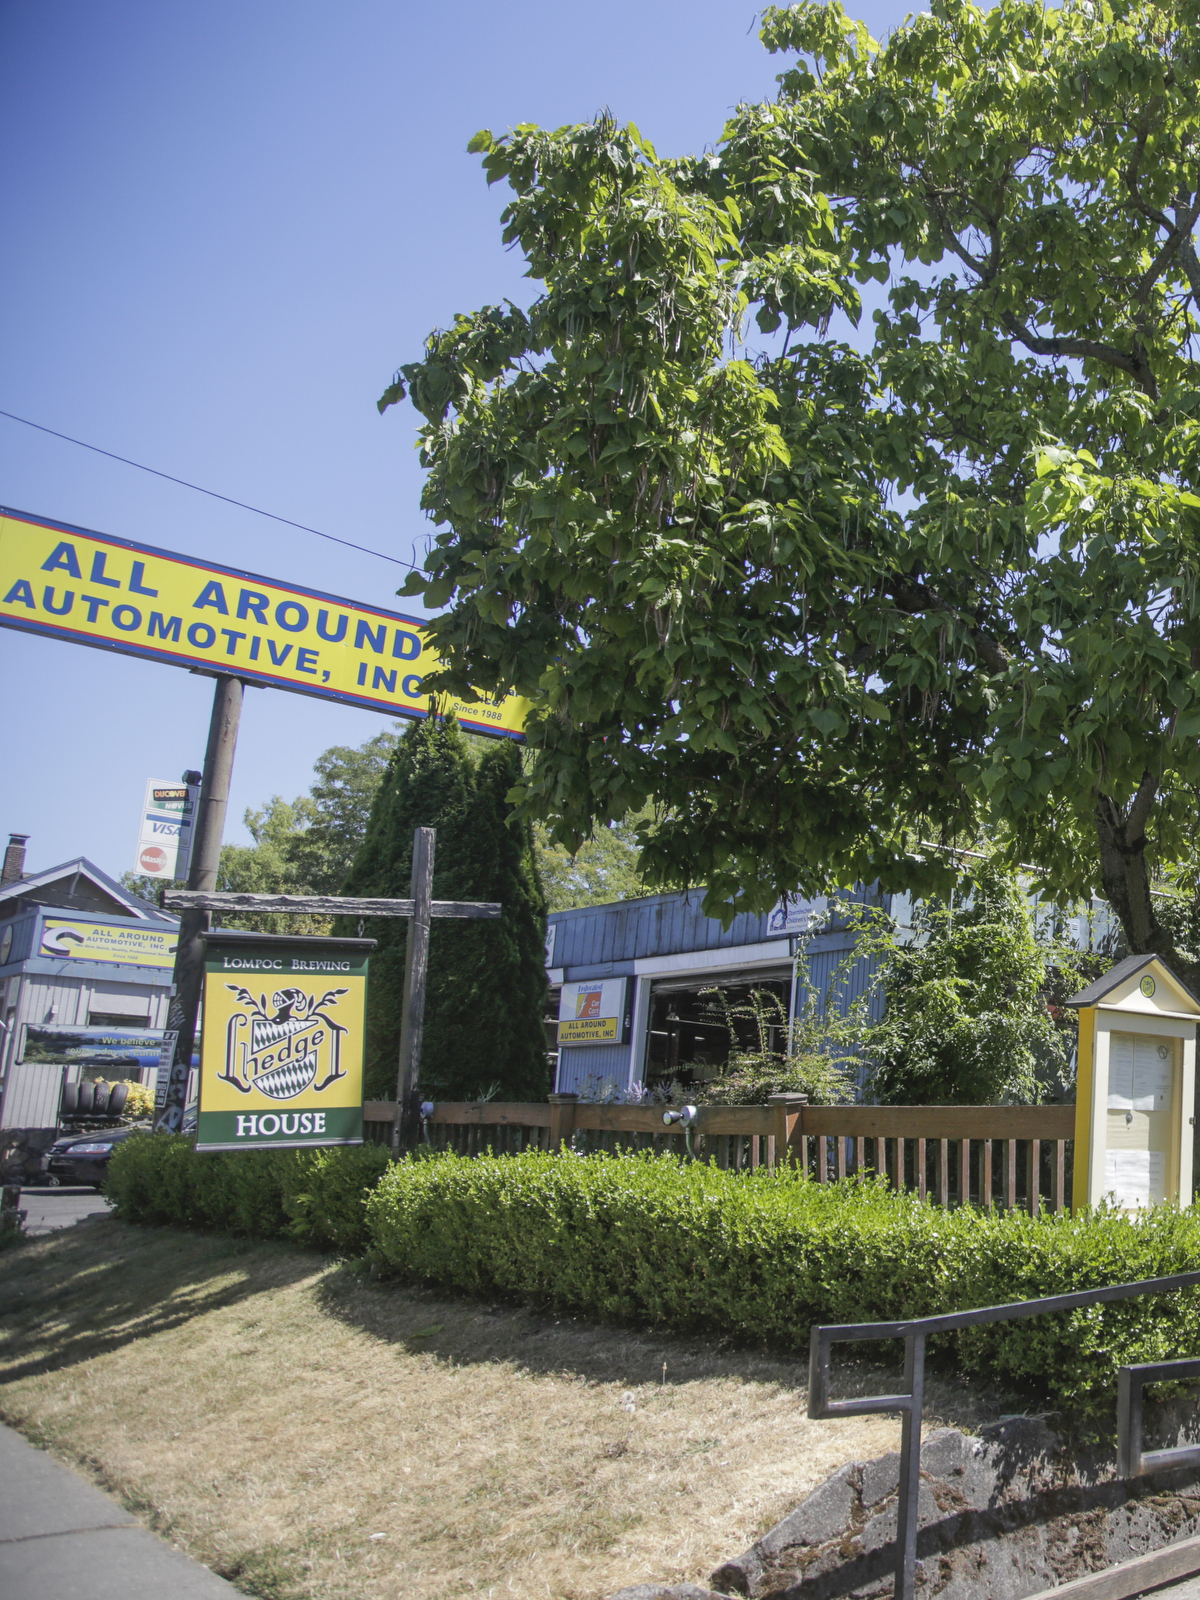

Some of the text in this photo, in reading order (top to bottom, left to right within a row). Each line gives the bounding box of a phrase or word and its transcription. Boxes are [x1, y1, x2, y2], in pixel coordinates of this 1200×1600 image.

[40, 541, 422, 661] ALL AROUND
[3, 579, 330, 683] AUTOMOTIVE,
[453, 703, 502, 720] Since 1988
[153, 822, 181, 837] VISA
[86, 936, 145, 948] AUTOMOTIVE,
[92, 929, 164, 942] ALL AROUND
[223, 957, 350, 971] LOMPOC BREWING
[578, 983, 603, 992] Federated
[581, 1020, 606, 1028] AROUND
[102, 1037, 155, 1046] We believe
[561, 1031, 600, 1039] AUTOMOTIVE,
[236, 1113, 326, 1137] HOUSE
